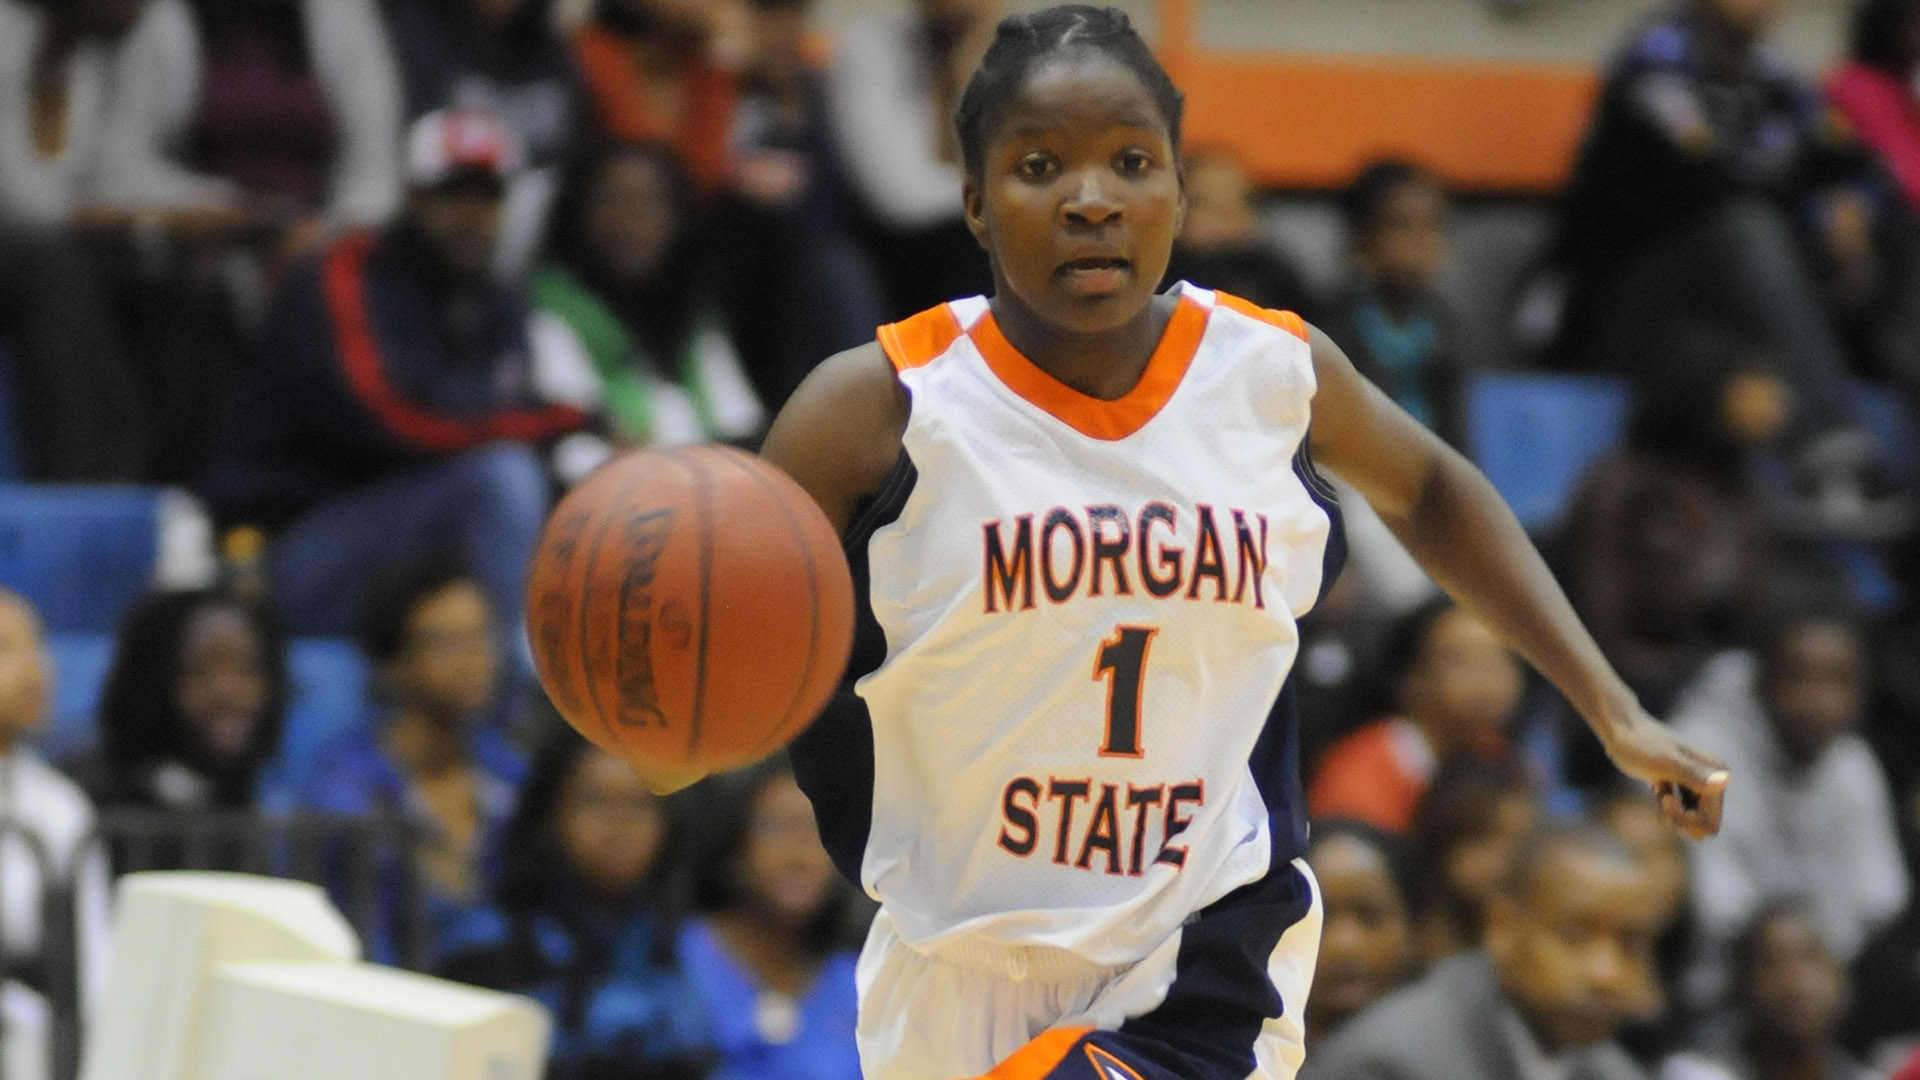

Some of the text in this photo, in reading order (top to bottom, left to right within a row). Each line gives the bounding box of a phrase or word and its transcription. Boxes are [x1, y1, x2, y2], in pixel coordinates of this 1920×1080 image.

[981, 500, 1268, 614] MORGAN
[1091, 623, 1160, 759] 1
[996, 775, 1205, 877] STATE
